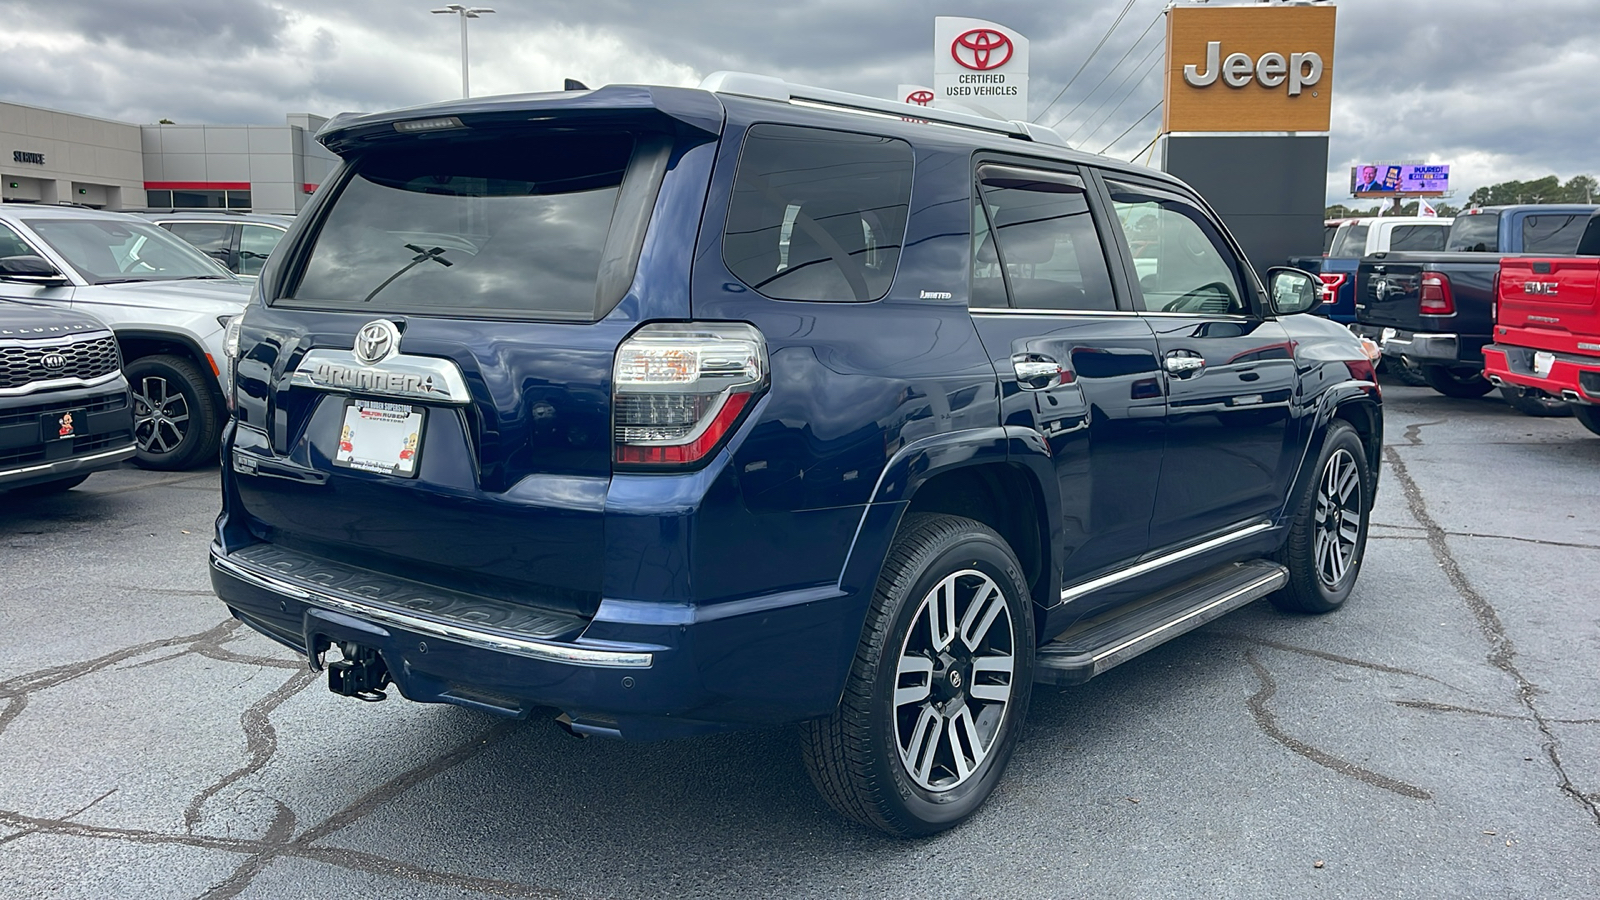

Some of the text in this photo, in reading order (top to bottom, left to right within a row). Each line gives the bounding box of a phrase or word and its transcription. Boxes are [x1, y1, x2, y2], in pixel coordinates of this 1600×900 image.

[1184, 41, 1323, 96] Jeep
[958, 74, 1005, 84] CERTIFIED
[946, 86, 1018, 96] USED VEHICLES
[13, 150, 45, 165] SERVICE
[1524, 281, 1559, 296] GMC
[46, 356, 65, 367] KIA
[313, 364, 422, 392] 4RUNNER
